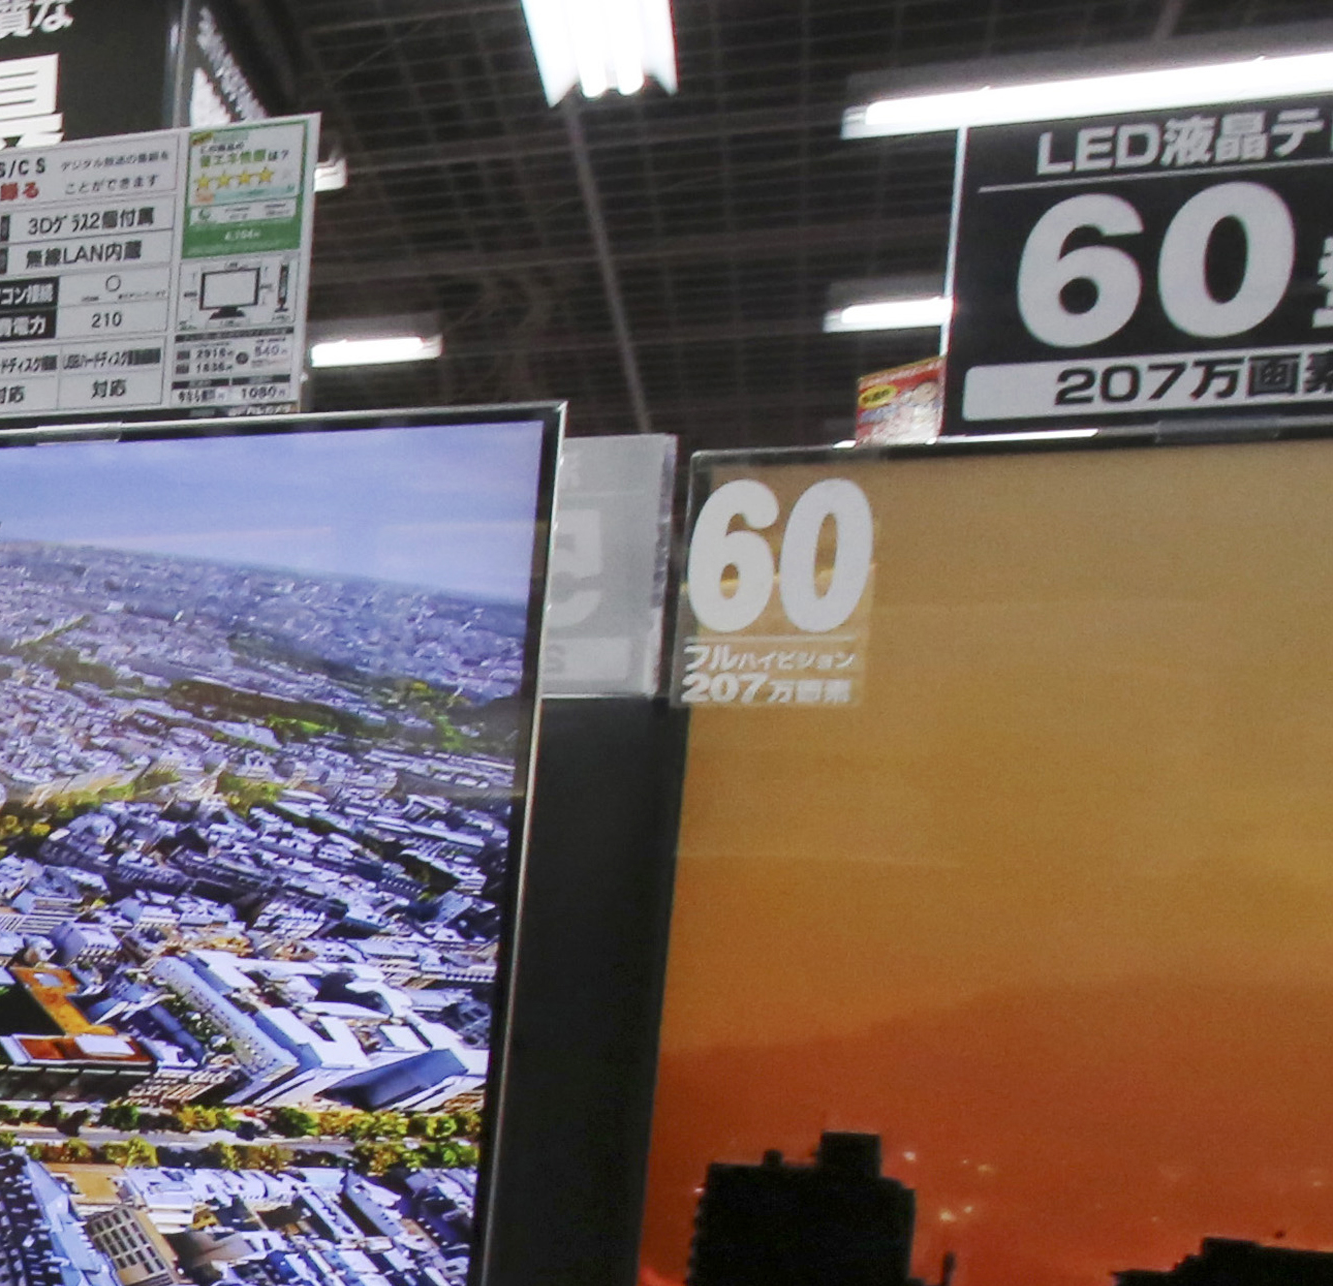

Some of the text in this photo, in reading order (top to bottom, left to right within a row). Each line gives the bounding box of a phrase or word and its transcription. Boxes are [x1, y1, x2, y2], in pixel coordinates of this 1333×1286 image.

[1037, 108, 1333, 175] LED液晶テ
[91, 311, 123, 329] 210
[687, 478, 874, 632] 60
